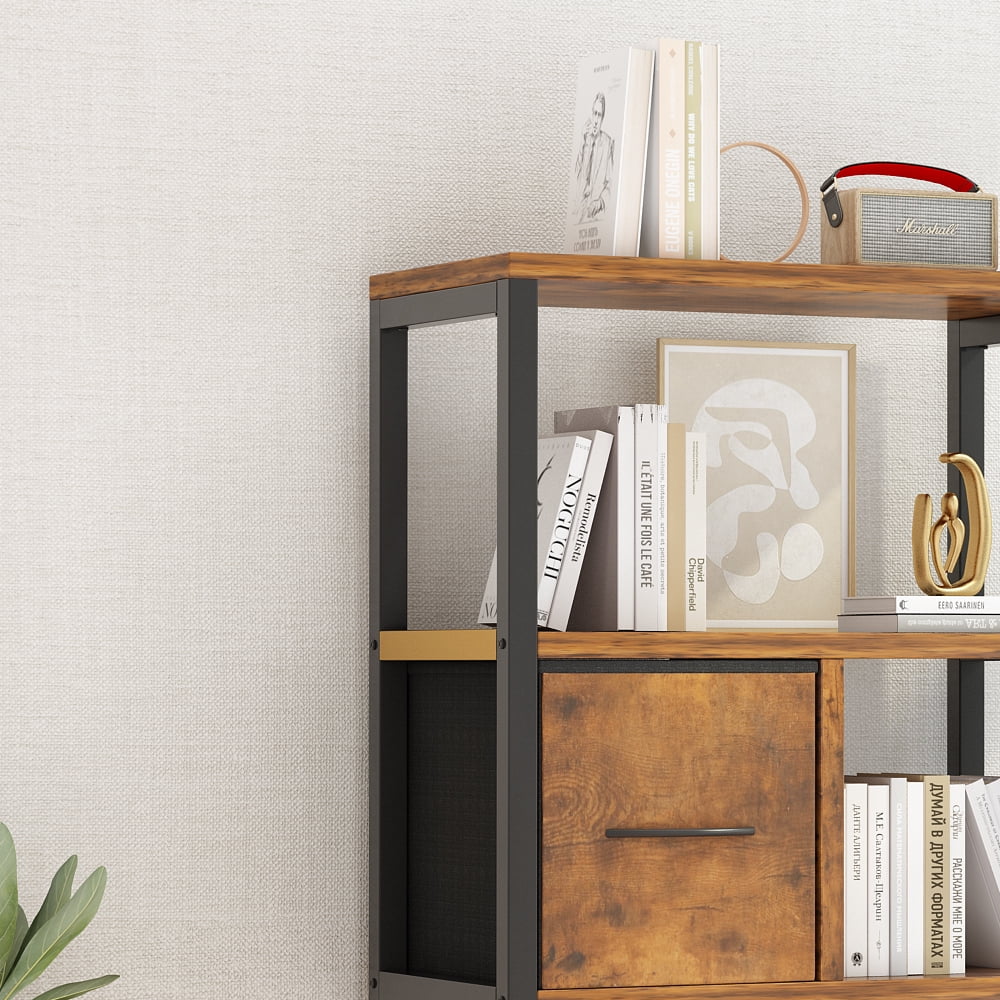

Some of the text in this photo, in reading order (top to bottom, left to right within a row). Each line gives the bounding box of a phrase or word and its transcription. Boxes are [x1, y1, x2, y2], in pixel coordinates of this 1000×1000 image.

[687, 112, 695, 131] WHY
[687, 133, 695, 144] DO
[687, 146, 695, 159] WE
[687, 160, 695, 180] LOVE
[664, 149, 680, 252] EUGENE ONEGIN
[896, 218, 960, 236] Marshall
[544, 474, 582, 580] NOGUCHI
[570, 494, 597, 562] Remodelista
[640, 460, 654, 588] IL ÉTAIT UNE FOIS LE CAFÉ
[688, 558, 696, 612] Chipperfield
[938, 601, 985, 610] EERO SAARINEN
[930, 782, 946, 825] ДУМАЙ
[852, 804, 860, 834] ДАНТЕ
[931, 830, 943, 838] В
[930, 842, 944, 888] ДРУГИХ
[952, 858, 962, 904] РАССКАЖИ
[931, 893, 944, 958] ФОРМАТАХ
[952, 906, 962, 924] МНЕ
[952, 936, 962, 959] МОРЕ
